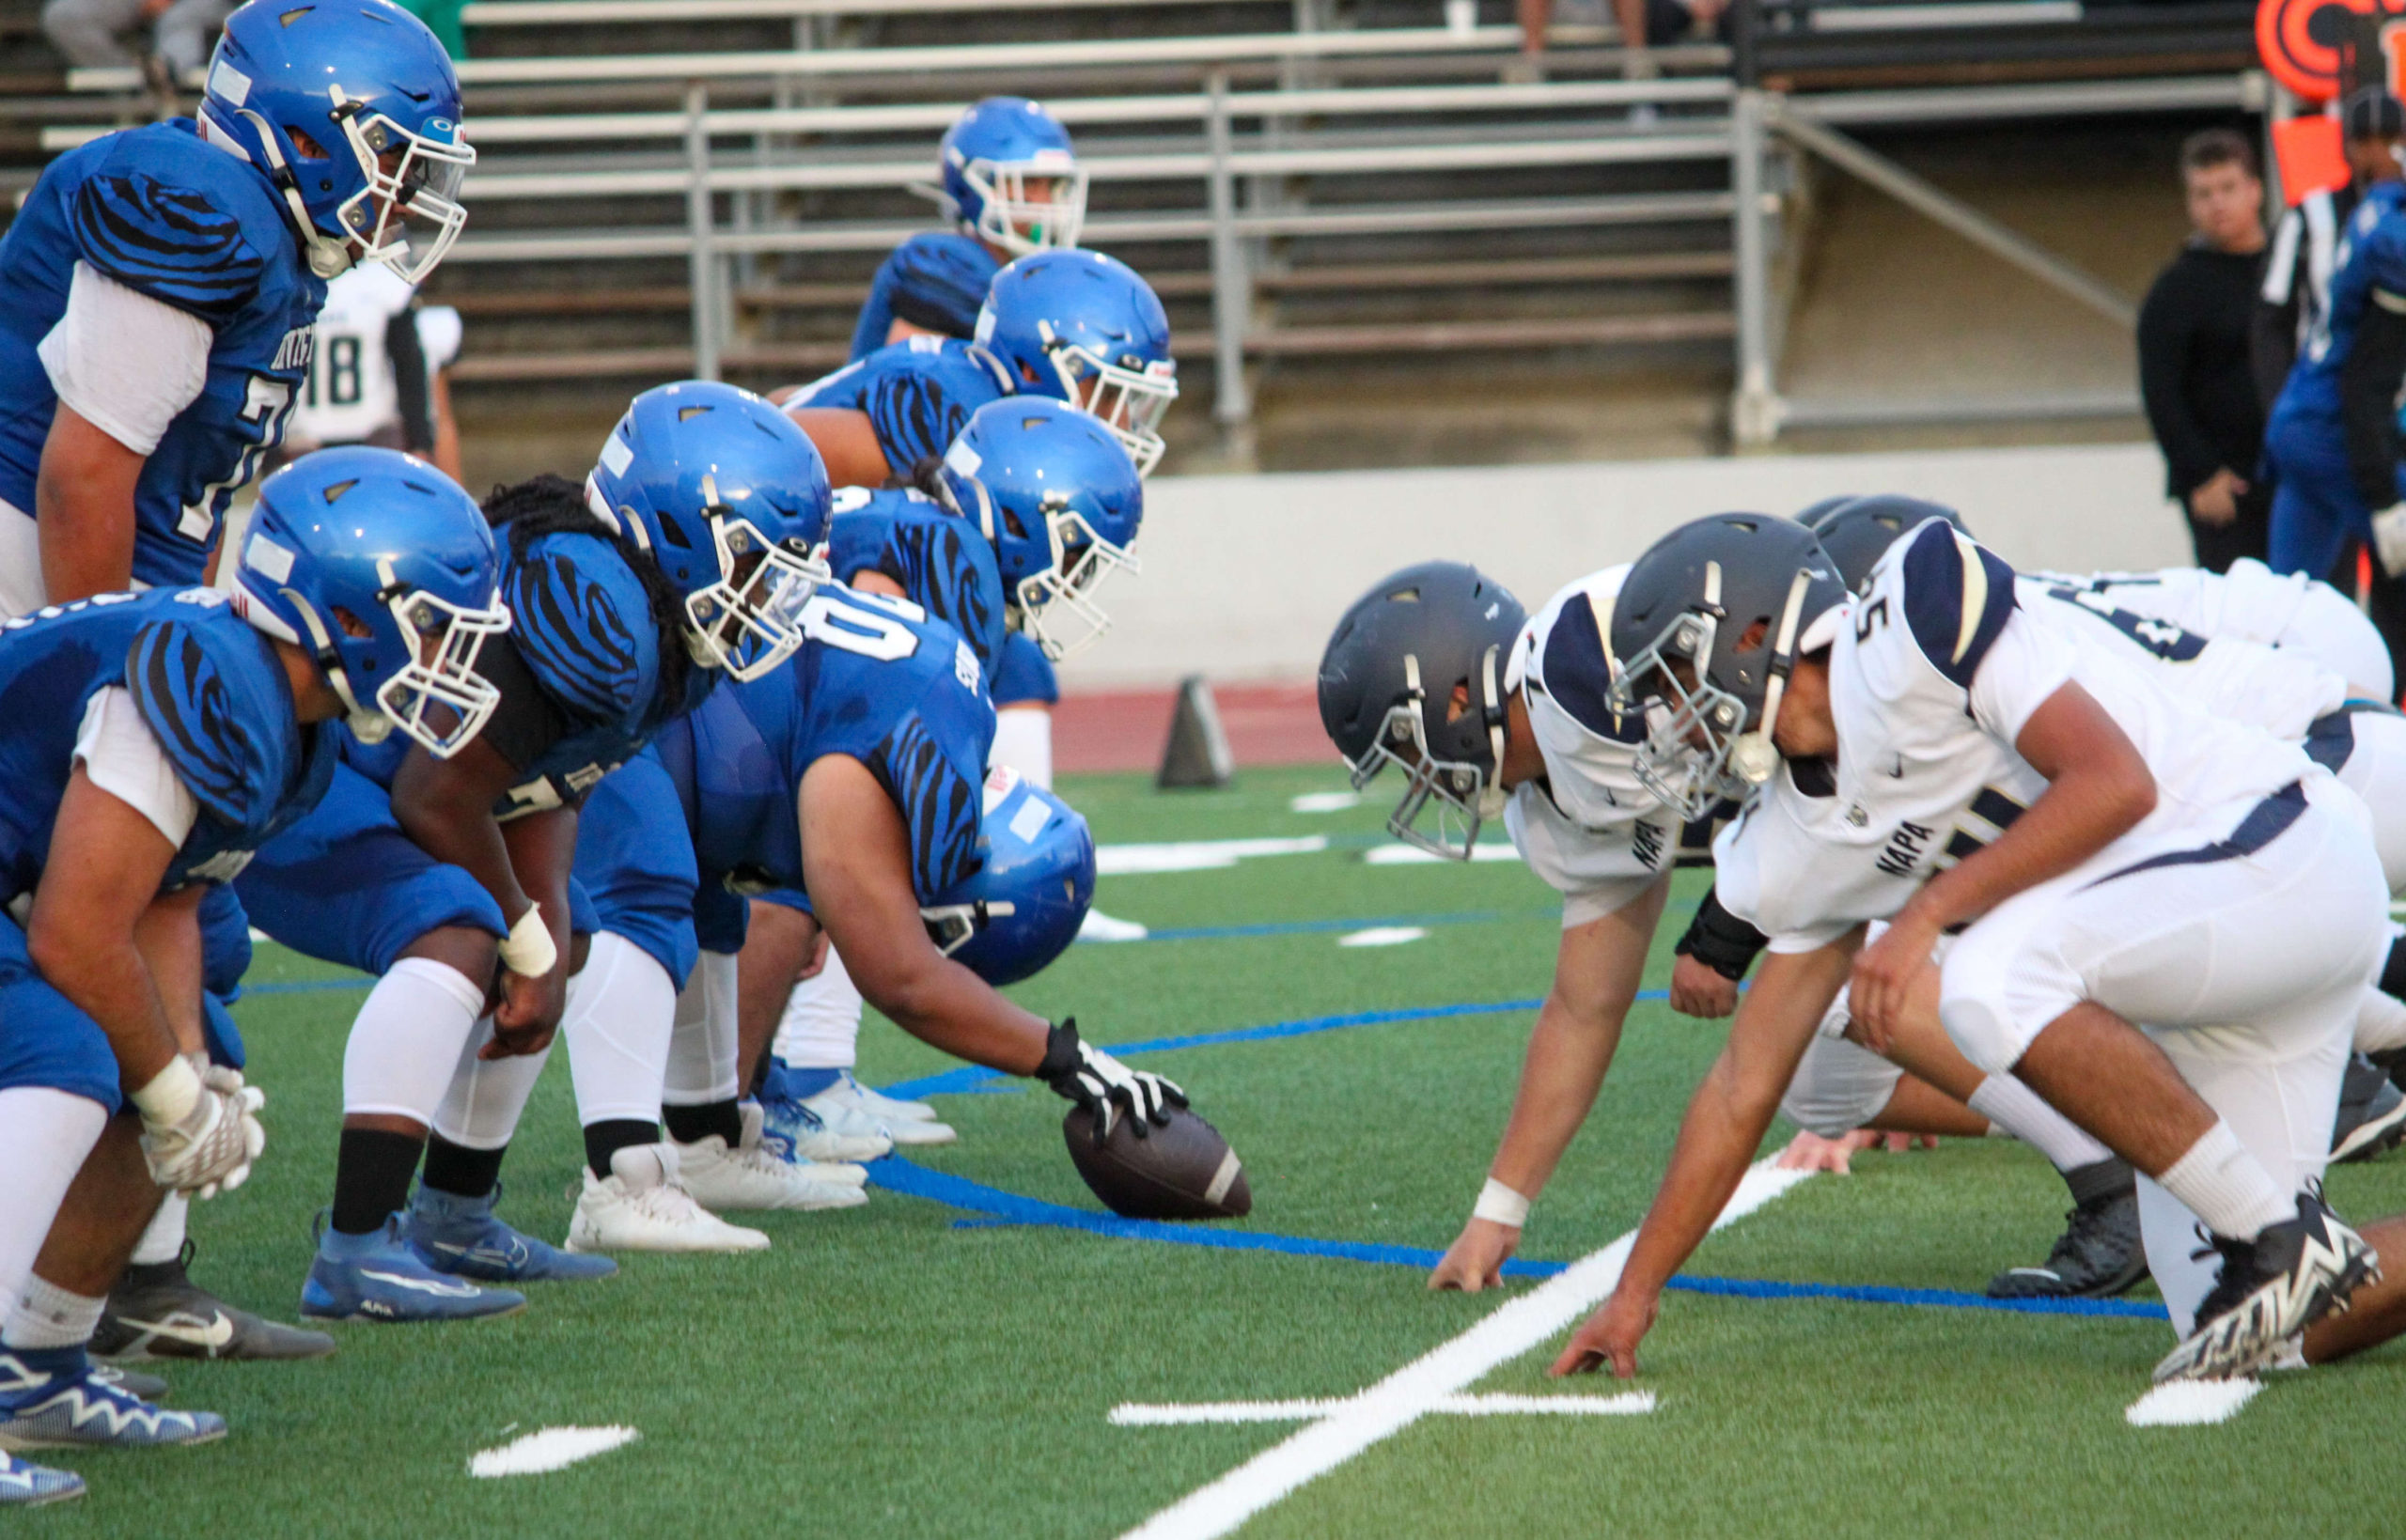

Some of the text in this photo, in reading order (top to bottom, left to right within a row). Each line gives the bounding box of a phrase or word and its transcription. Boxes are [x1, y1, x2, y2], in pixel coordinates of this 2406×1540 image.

[306, 333, 361, 408] 18
[176, 374, 299, 543] 7
[1633, 818, 1666, 872] NAPA
[1875, 819, 1936, 879] NAPA
